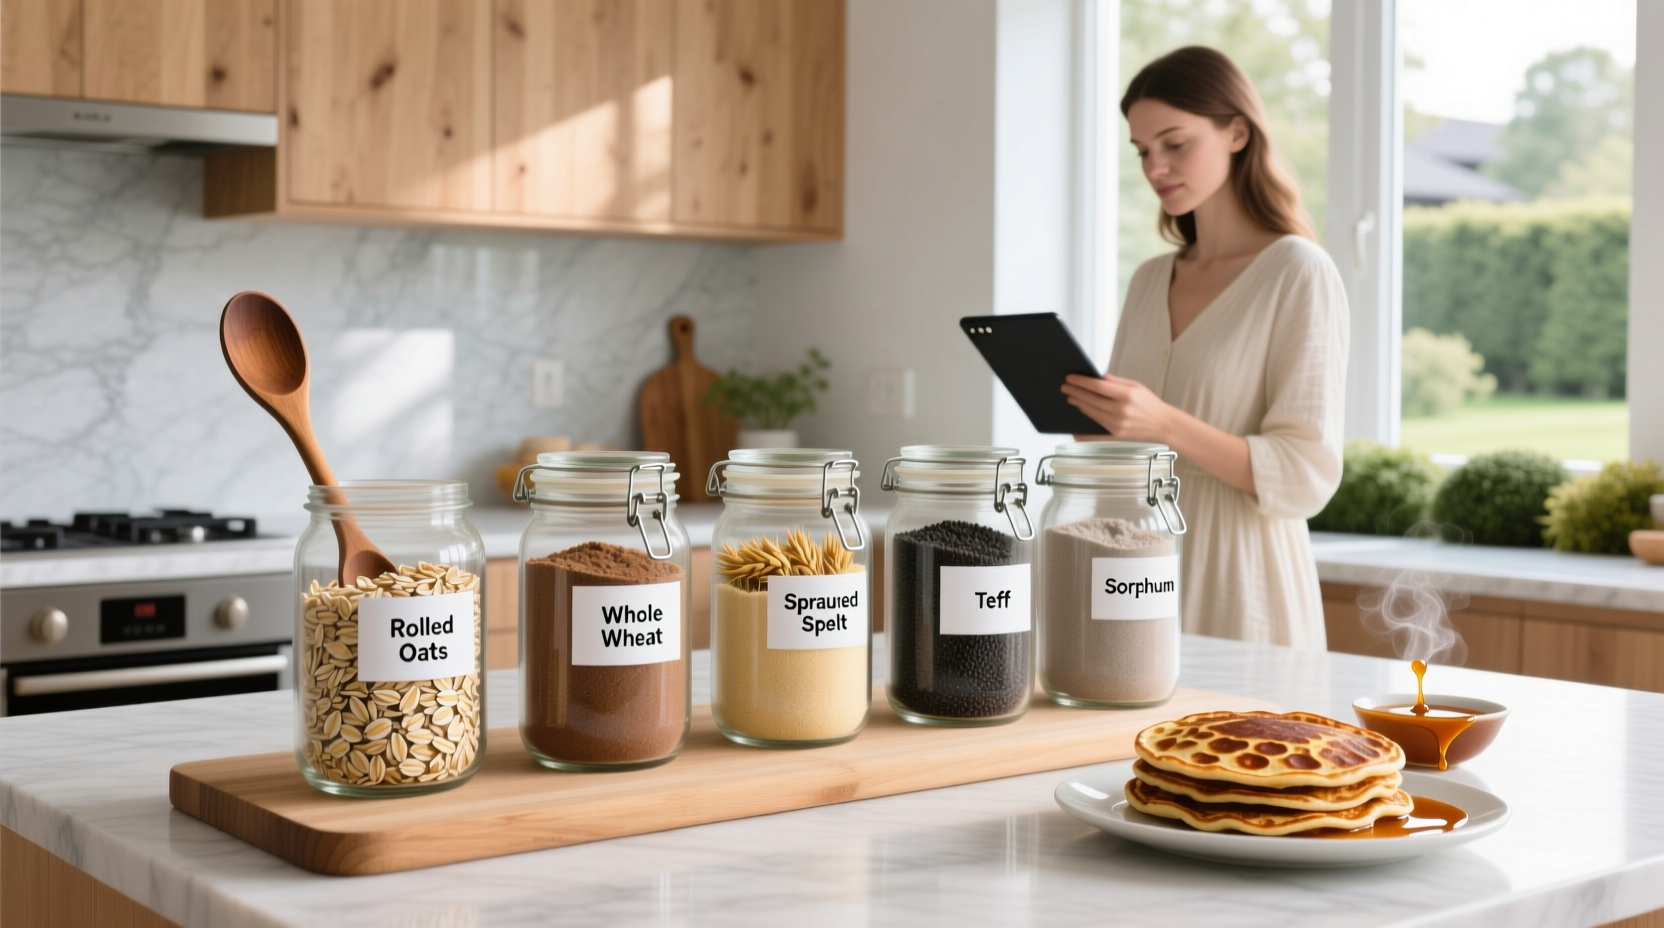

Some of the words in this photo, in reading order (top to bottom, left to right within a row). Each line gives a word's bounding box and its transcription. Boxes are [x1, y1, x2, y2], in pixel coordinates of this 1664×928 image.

[974, 590, 1012, 609] Teff
[601, 604, 663, 624] Whole
[391, 614, 454, 638] Rolled
[801, 613, 848, 637] Spelt
[601, 628, 663, 648] Wheat
[399, 642, 448, 663] Oats
